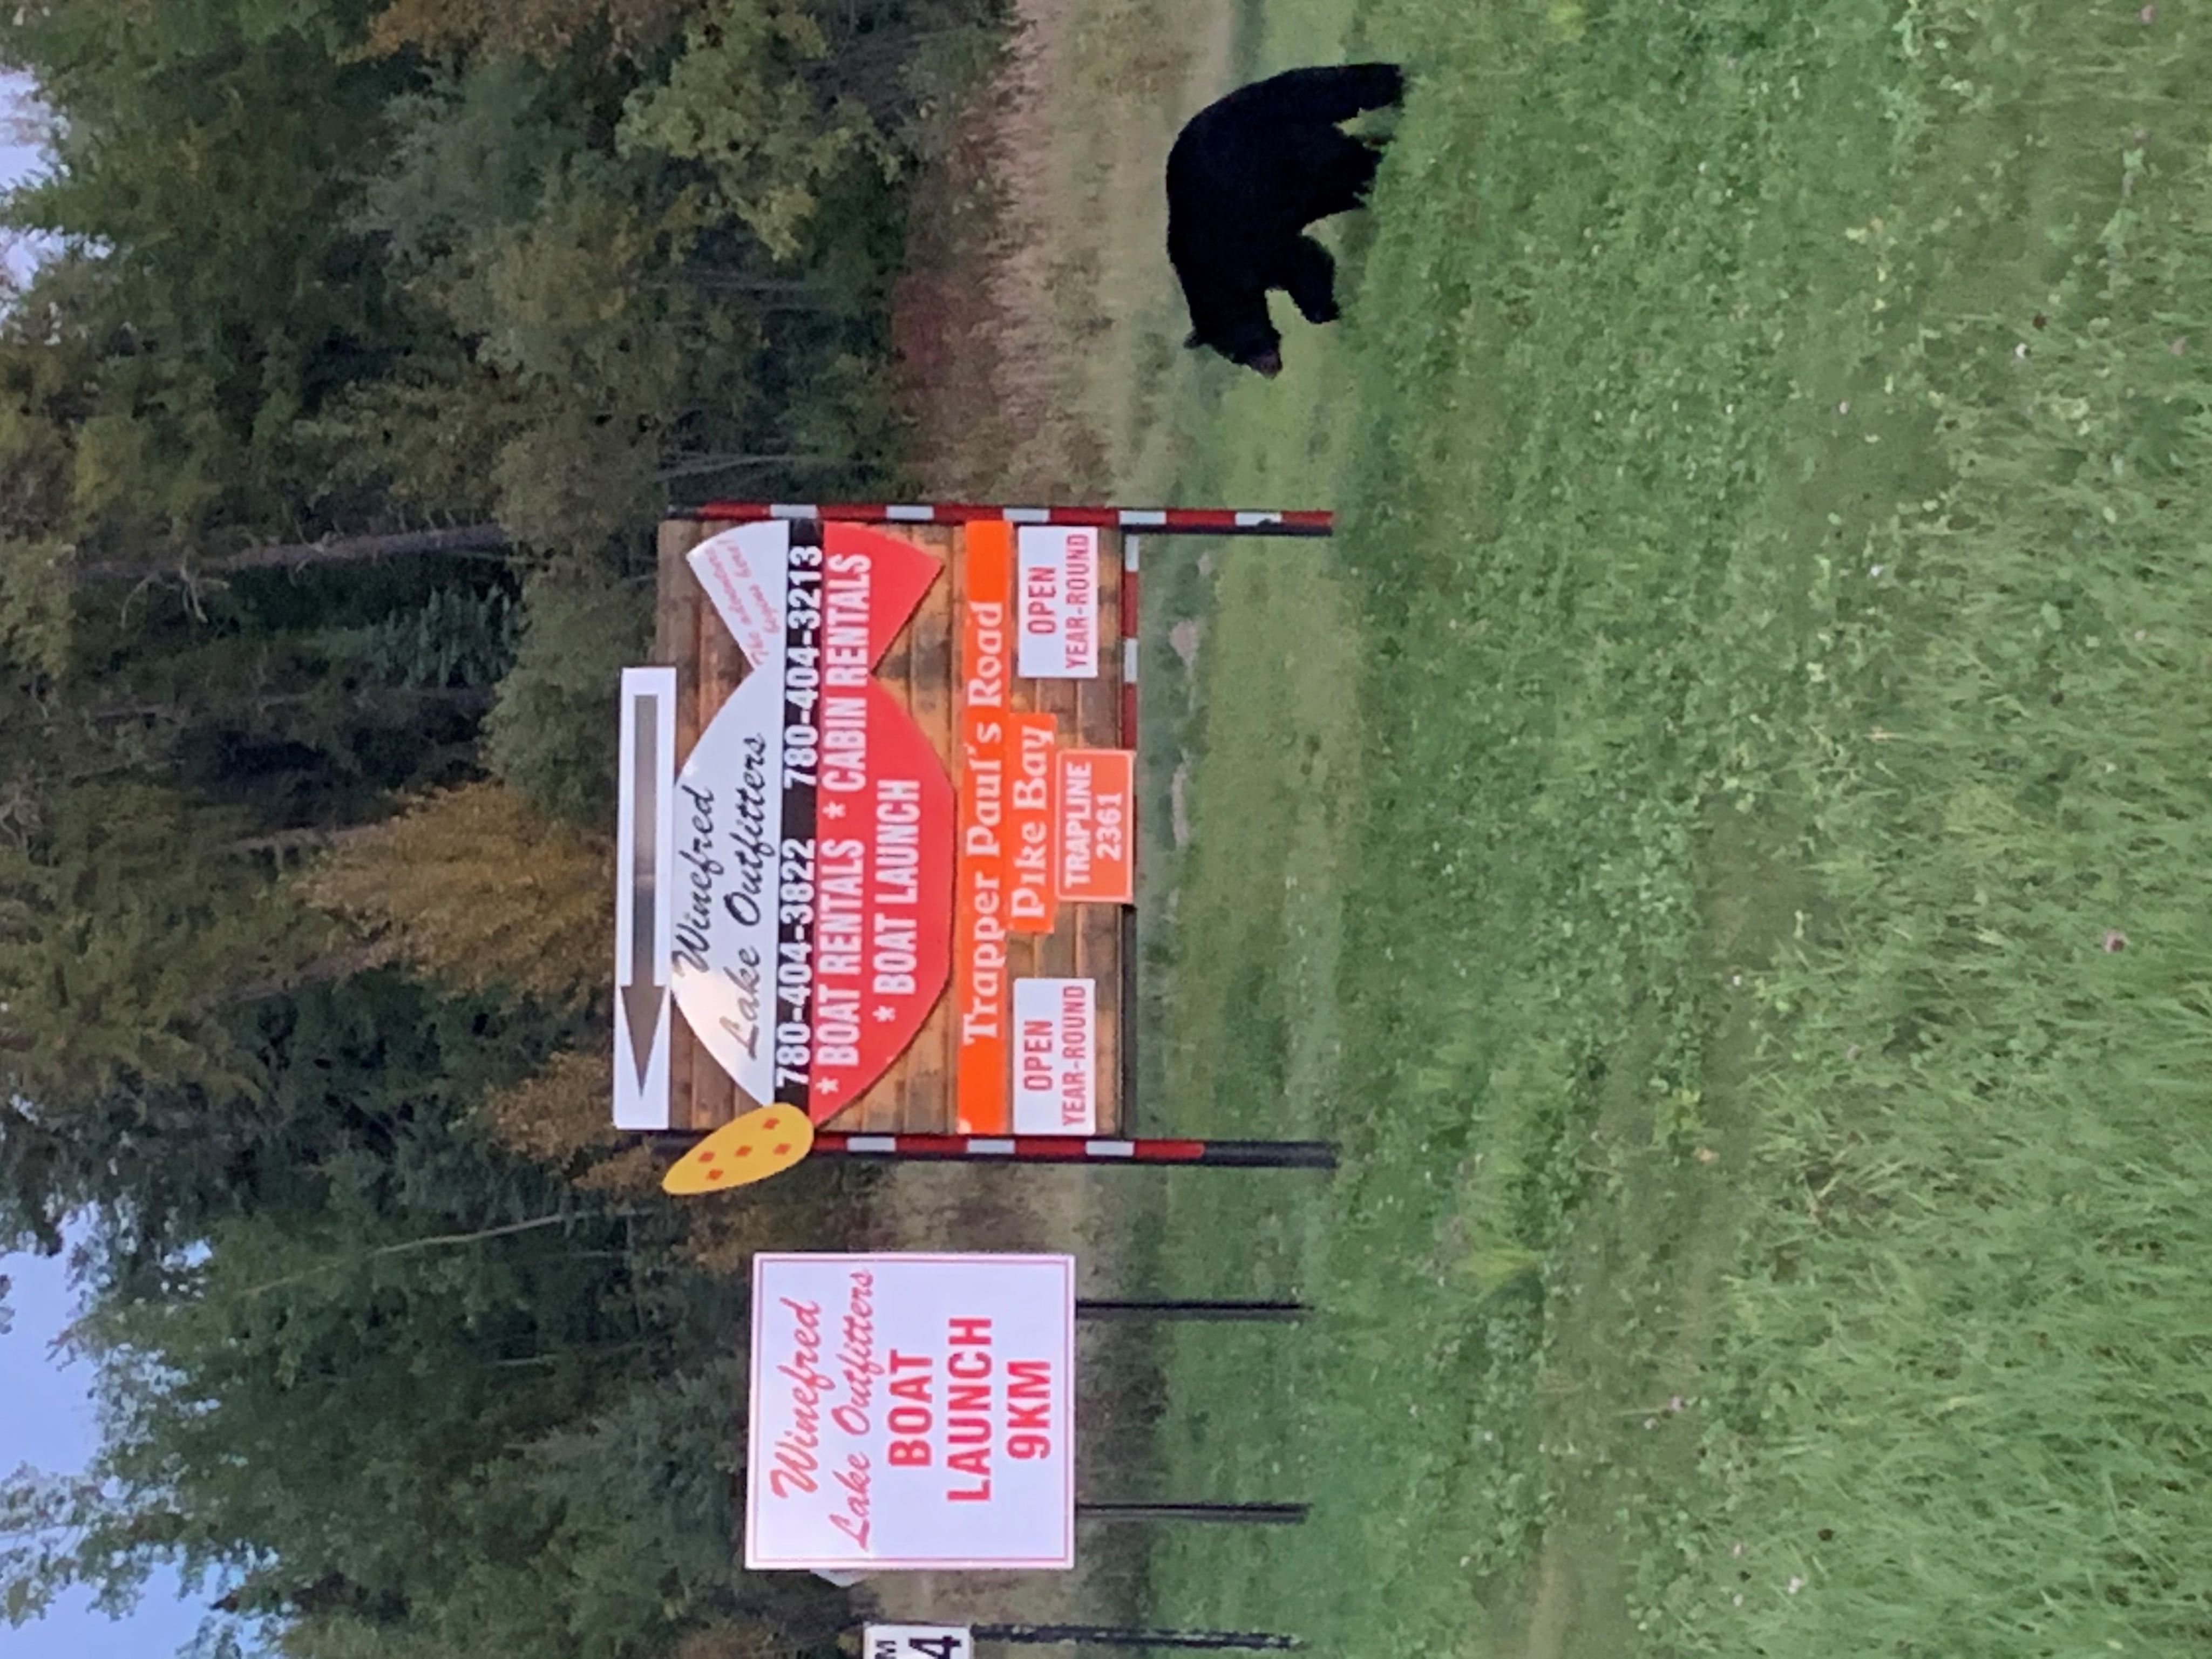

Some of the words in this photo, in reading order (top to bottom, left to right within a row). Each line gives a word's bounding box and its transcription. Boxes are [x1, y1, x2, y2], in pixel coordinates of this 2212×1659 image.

[825, 553, 871, 686] RENTALS
[967, 600, 1003, 708] Road
[1027, 566, 1057, 635] OPEN
[1065, 534, 1090, 669] YEAR-ROUND
[783, 545, 823, 788] 780-404-3213
[822, 697, 867, 791] CABIN
[963, 722, 1003, 857] Paul's
[1012, 725, 1055, 810] Bay
[671, 784, 723, 978] Winefred
[723, 732, 775, 926] Outfitters
[874, 779, 920, 904] LAUNCH
[1010, 822, 1047, 919] Pike
[1064, 761, 1093, 888] TRAPLINE
[1095, 792, 1123, 861] 2361
[776, 838, 815, 1087] 780-404-3822
[818, 839, 865, 975] RENTALS
[872, 912, 917, 995] BOAT
[962, 871, 1007, 1045] Trapper
[719, 946, 760, 1059] Lake
[817, 984, 861, 1065] BOAT
[1023, 1019, 1053, 1091] OPEN
[1061, 985, 1087, 1126] YEAR-ROUND
[769, 1297, 835, 1498] Winefred
[831, 1269, 884, 1436] Outfitters
[888, 1349, 932, 1467] BOAT
[947, 1317, 992, 1501] LAUNCH
[1007, 1361, 1050, 1459] 9KM
[829, 1452, 870, 1551] Lake
[908, 1635, 962, 1659] 4
